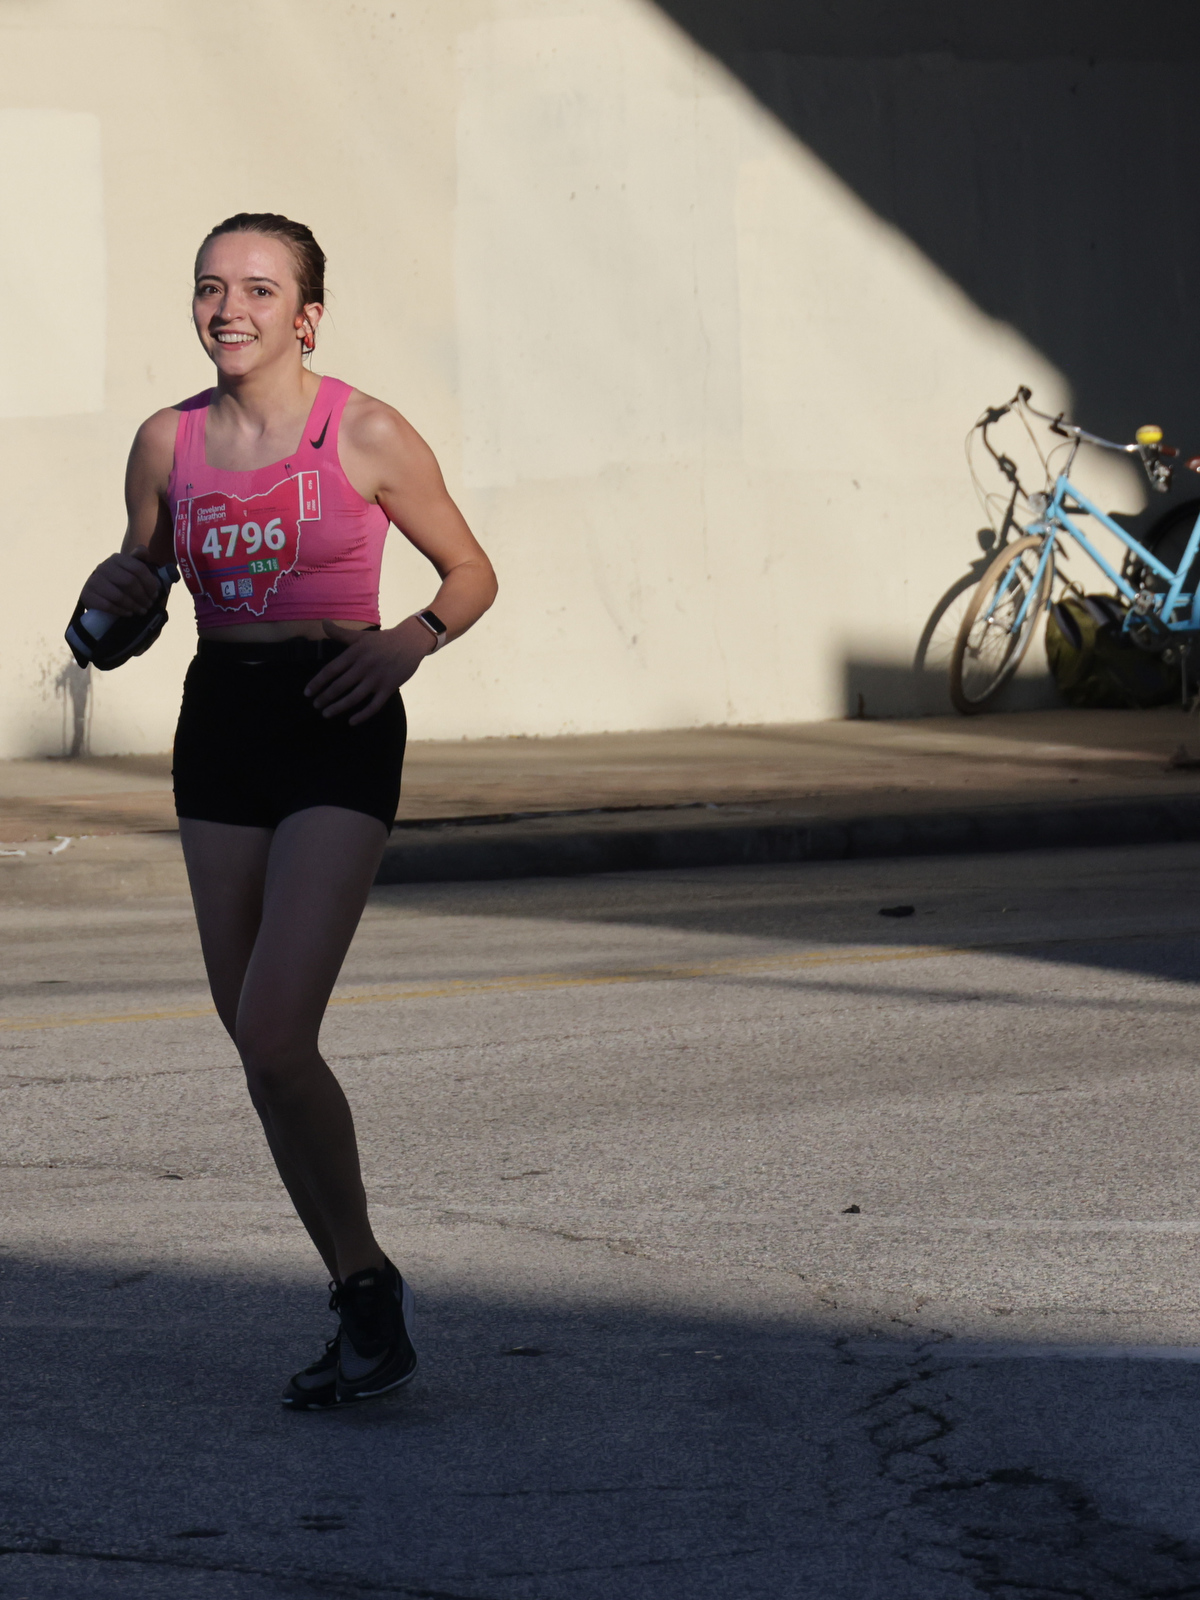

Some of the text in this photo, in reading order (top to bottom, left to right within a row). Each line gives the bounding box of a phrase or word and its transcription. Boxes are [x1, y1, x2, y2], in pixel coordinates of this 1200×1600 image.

[197, 503, 226, 516] Cleveland
[197, 511, 226, 522] Marathon
[201, 517, 286, 559] 4796
[180, 557, 192, 579] 4796
[250, 559, 273, 573] 13.1
